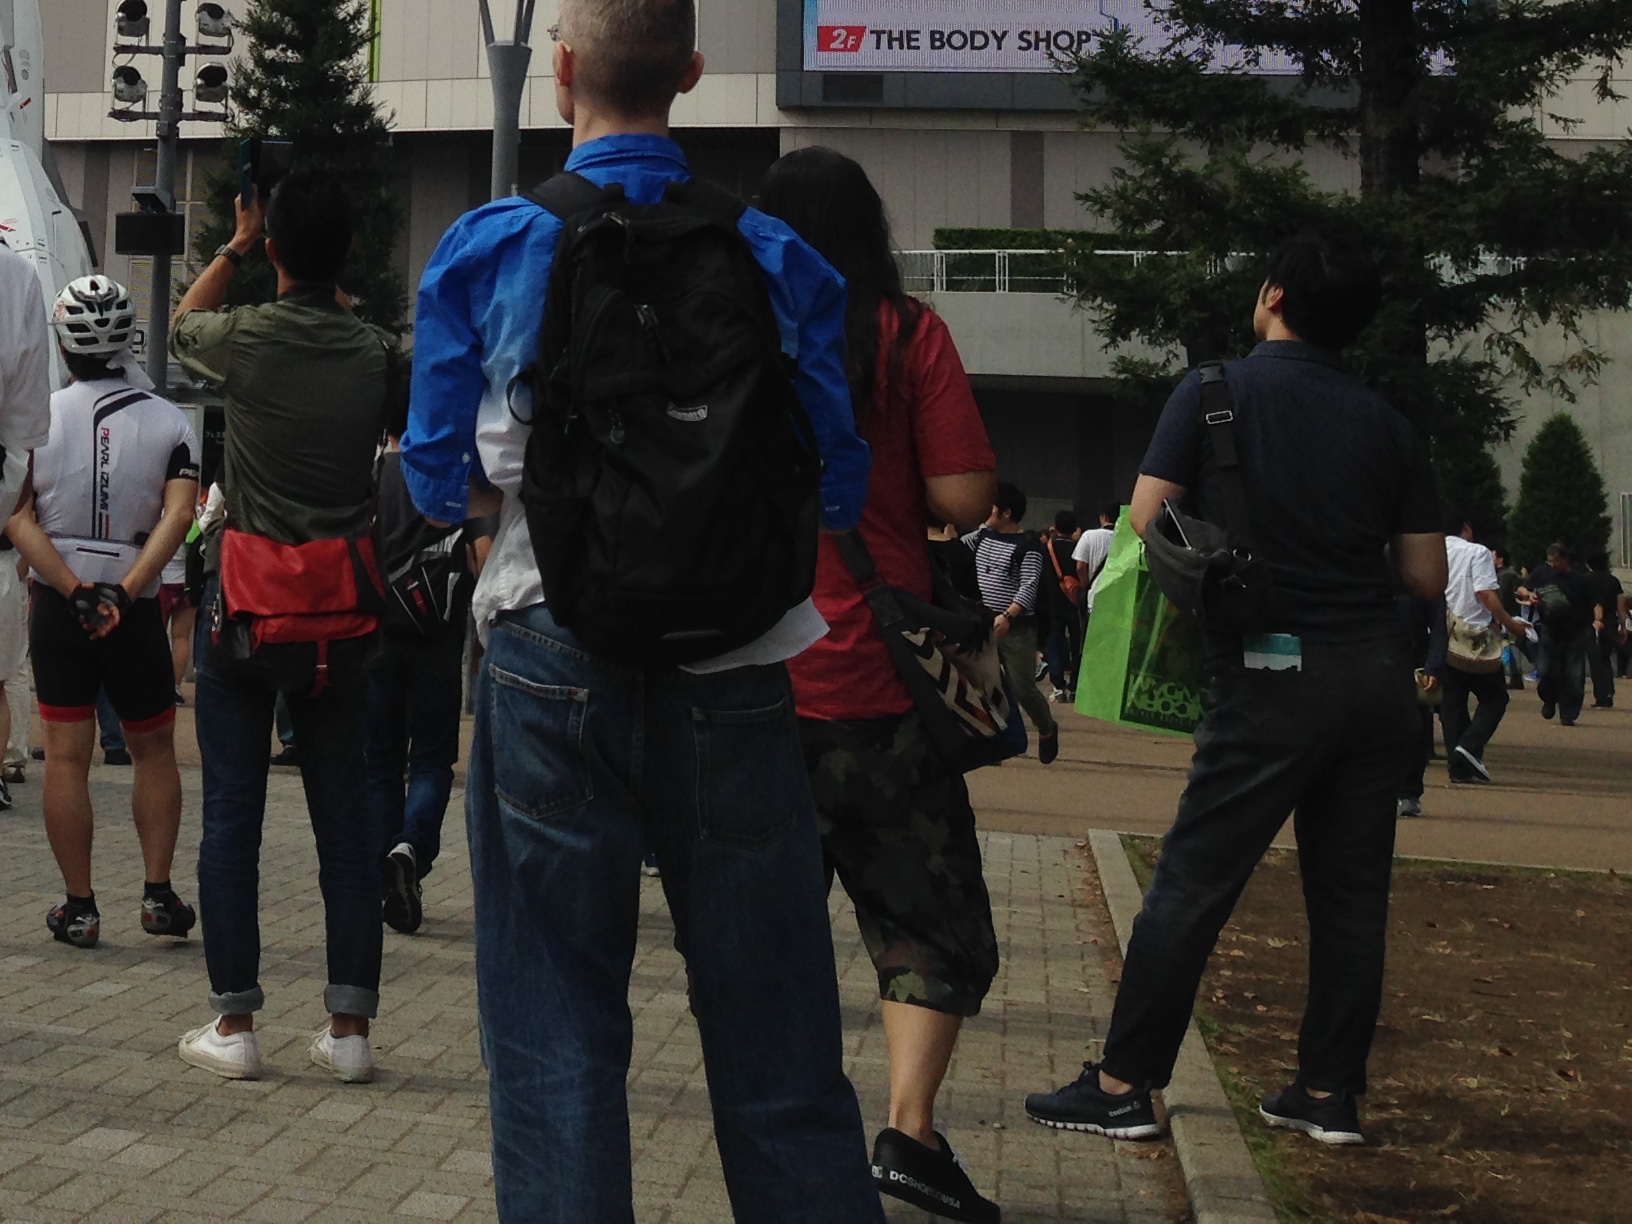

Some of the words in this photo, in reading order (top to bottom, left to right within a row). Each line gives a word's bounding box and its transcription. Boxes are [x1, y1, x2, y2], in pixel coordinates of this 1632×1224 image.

[829, 28, 857, 49] 2F
[870, 30, 920, 51] THE
[929, 29, 1008, 51] BODY
[1017, 30, 1092, 51] SHOP
[100, 427, 110, 469] PEARL
